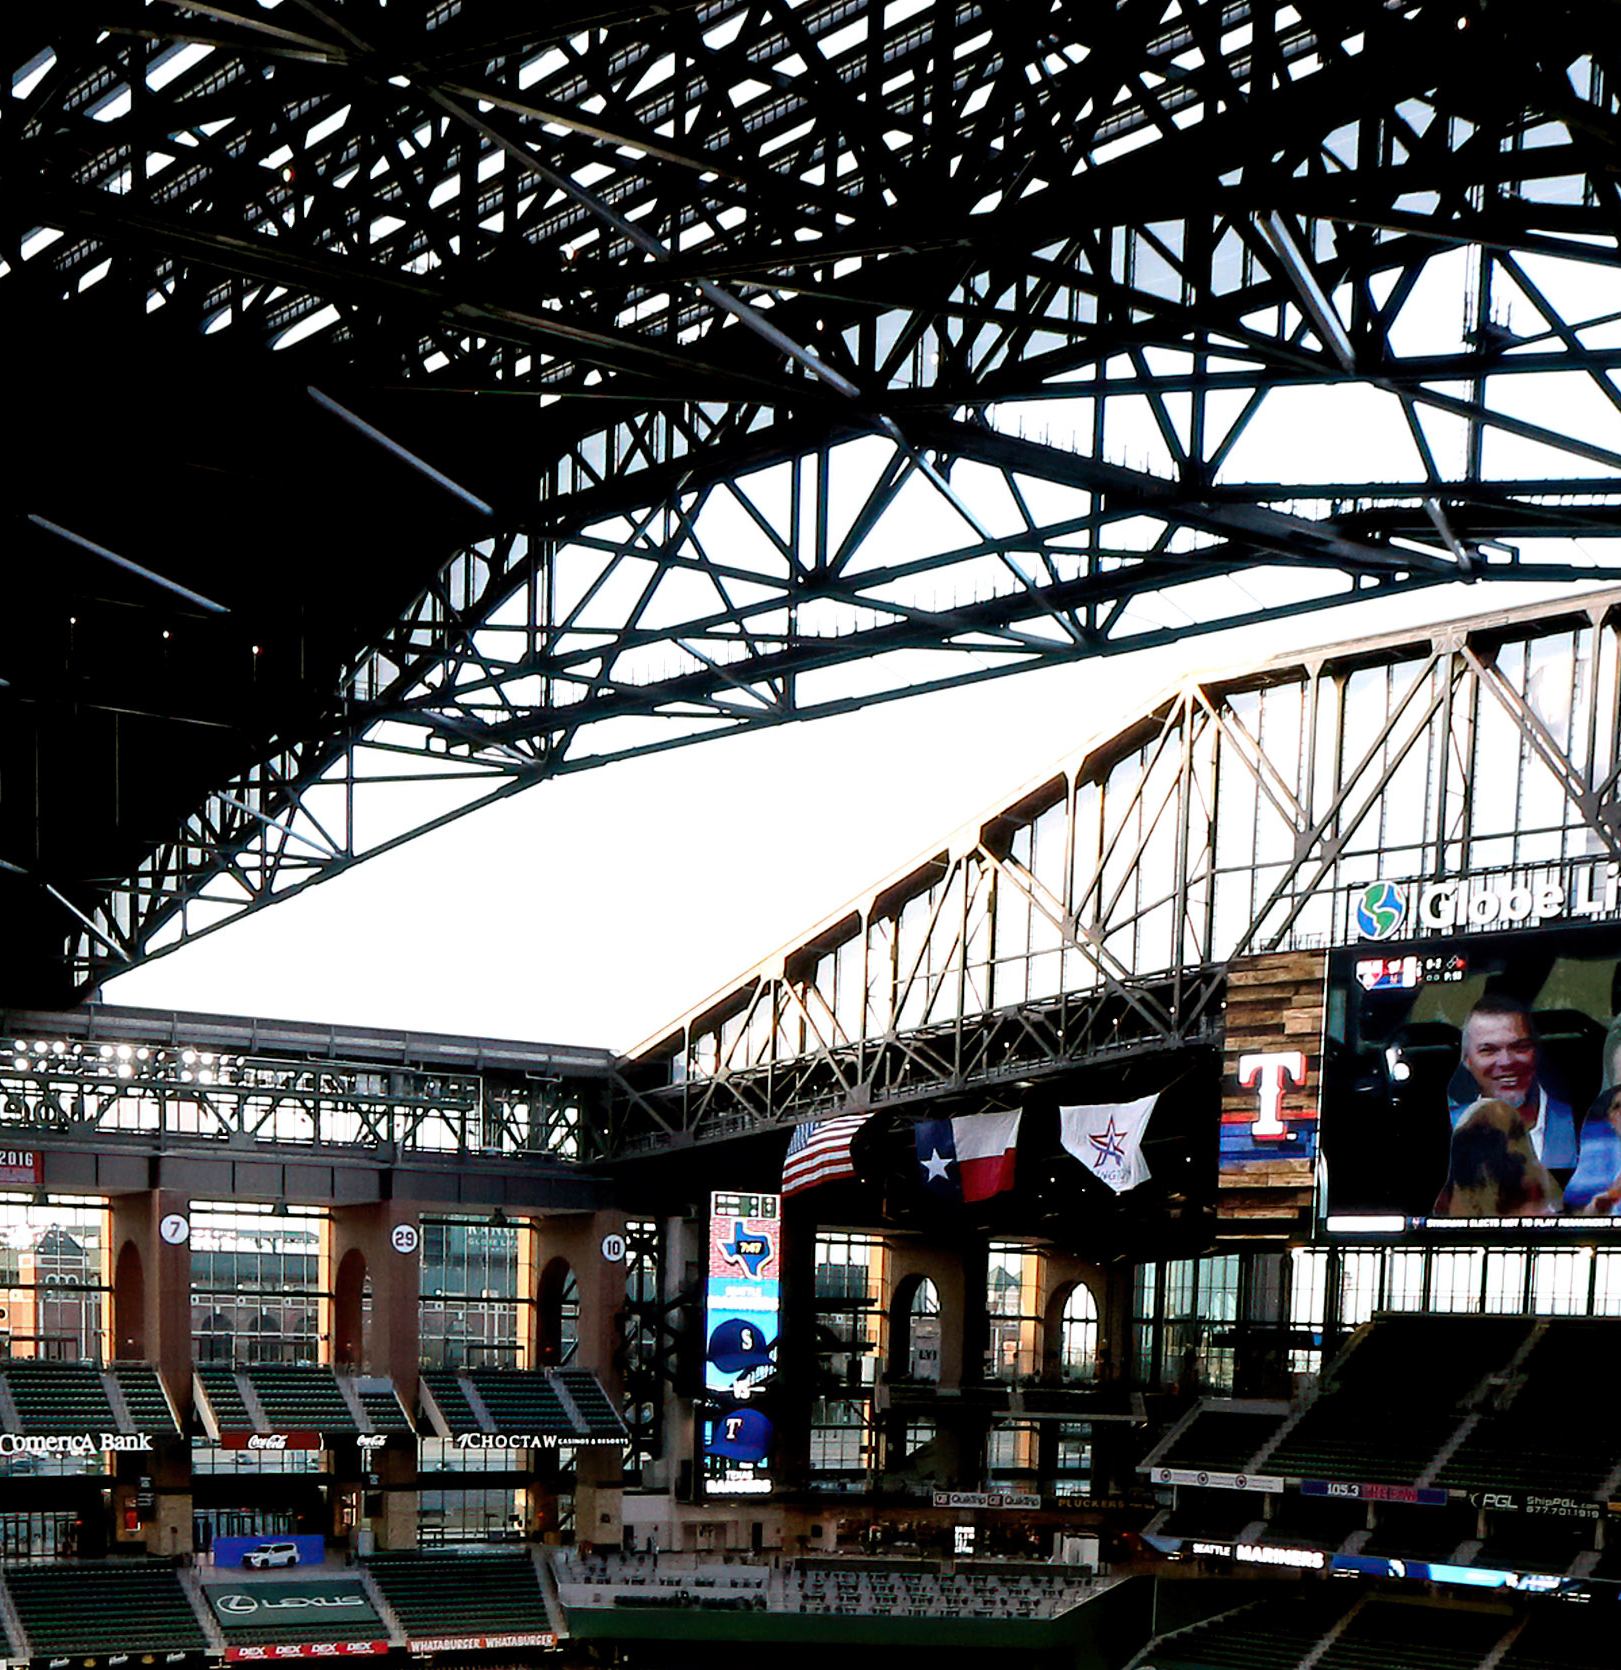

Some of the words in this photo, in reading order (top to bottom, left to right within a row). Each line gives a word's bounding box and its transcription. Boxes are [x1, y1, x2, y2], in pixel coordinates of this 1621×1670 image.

[1419, 881, 1565, 930] Globe
[1238, 1050, 1306, 1141] T
[169, 1220, 180, 1239] 7
[394, 1230, 414, 1248] 29
[606, 1241, 619, 1256] 10
[726, 1417, 742, 1440] T
[99, 1432, 154, 1452] Bank
[466, 1432, 558, 1449] CHOCTAW
[1192, 1542, 1231, 1557] SEATTLE
[261, 1595, 366, 1608] LEXUS
[275, 1643, 302, 1655] DEX
[310, 1642, 338, 1654] DEX
[346, 1640, 374, 1652] DEX
[411, 1638, 481, 1653] WHATABURGER
[485, 1634, 554, 1650] WHATABURGER
[239, 1645, 267, 1657] DEX
